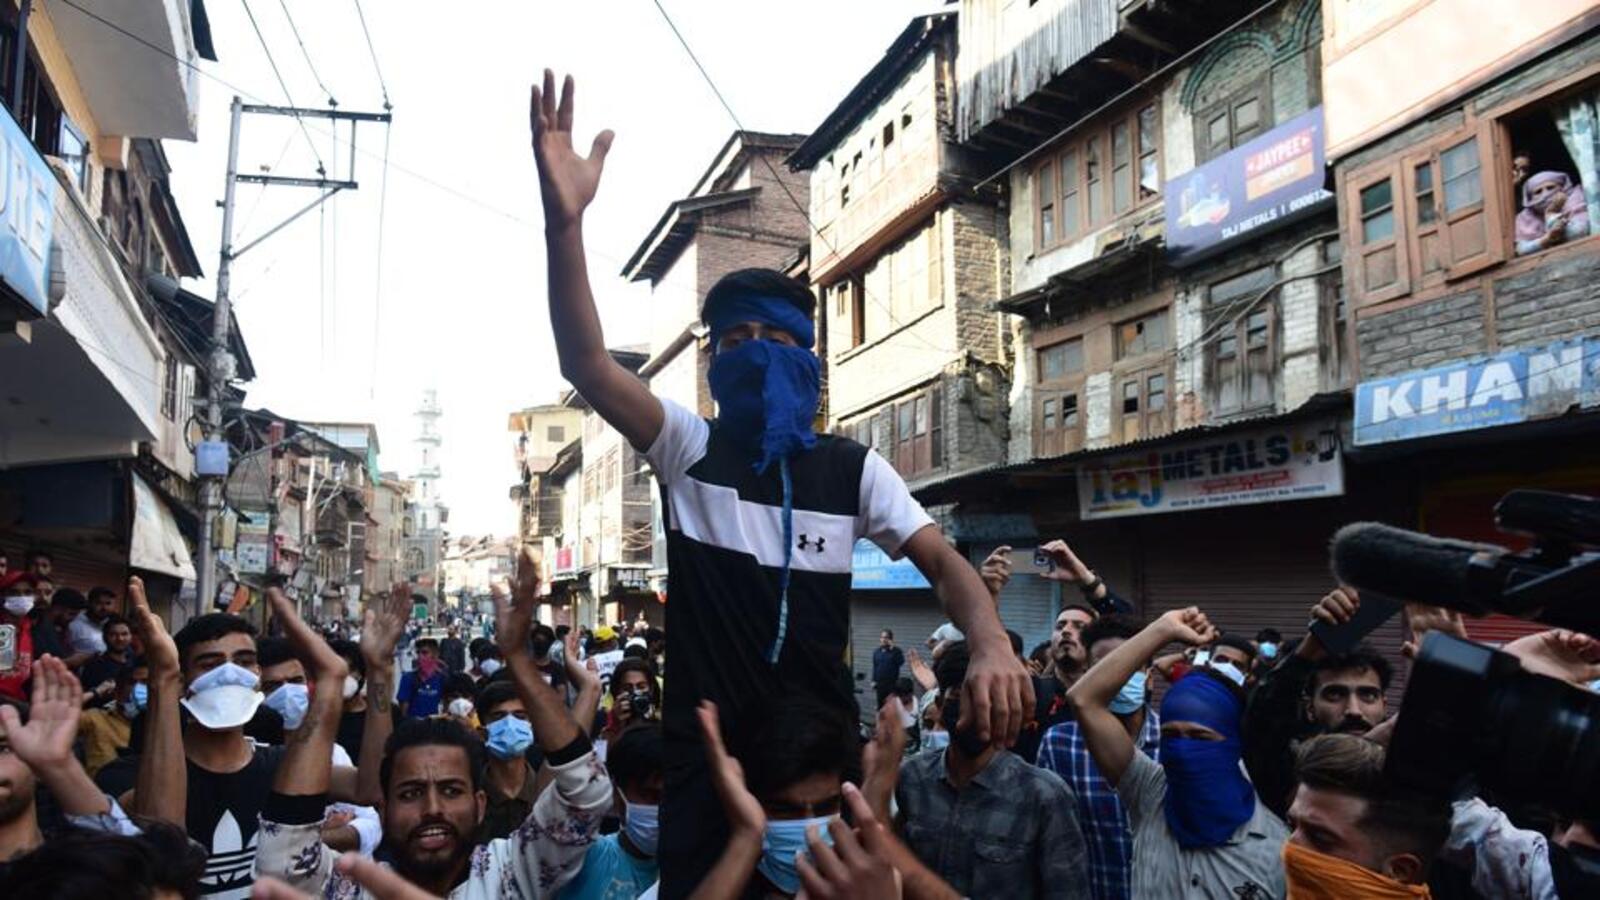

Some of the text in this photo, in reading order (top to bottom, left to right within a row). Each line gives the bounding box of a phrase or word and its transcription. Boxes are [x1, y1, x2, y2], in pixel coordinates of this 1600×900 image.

[1256, 137, 1303, 170] JAYPEE
[0, 131, 46, 263] RE
[1221, 225, 1238, 239] TAJ
[1240, 208, 1277, 232] METALS
[1162, 433, 1292, 481] METALS
